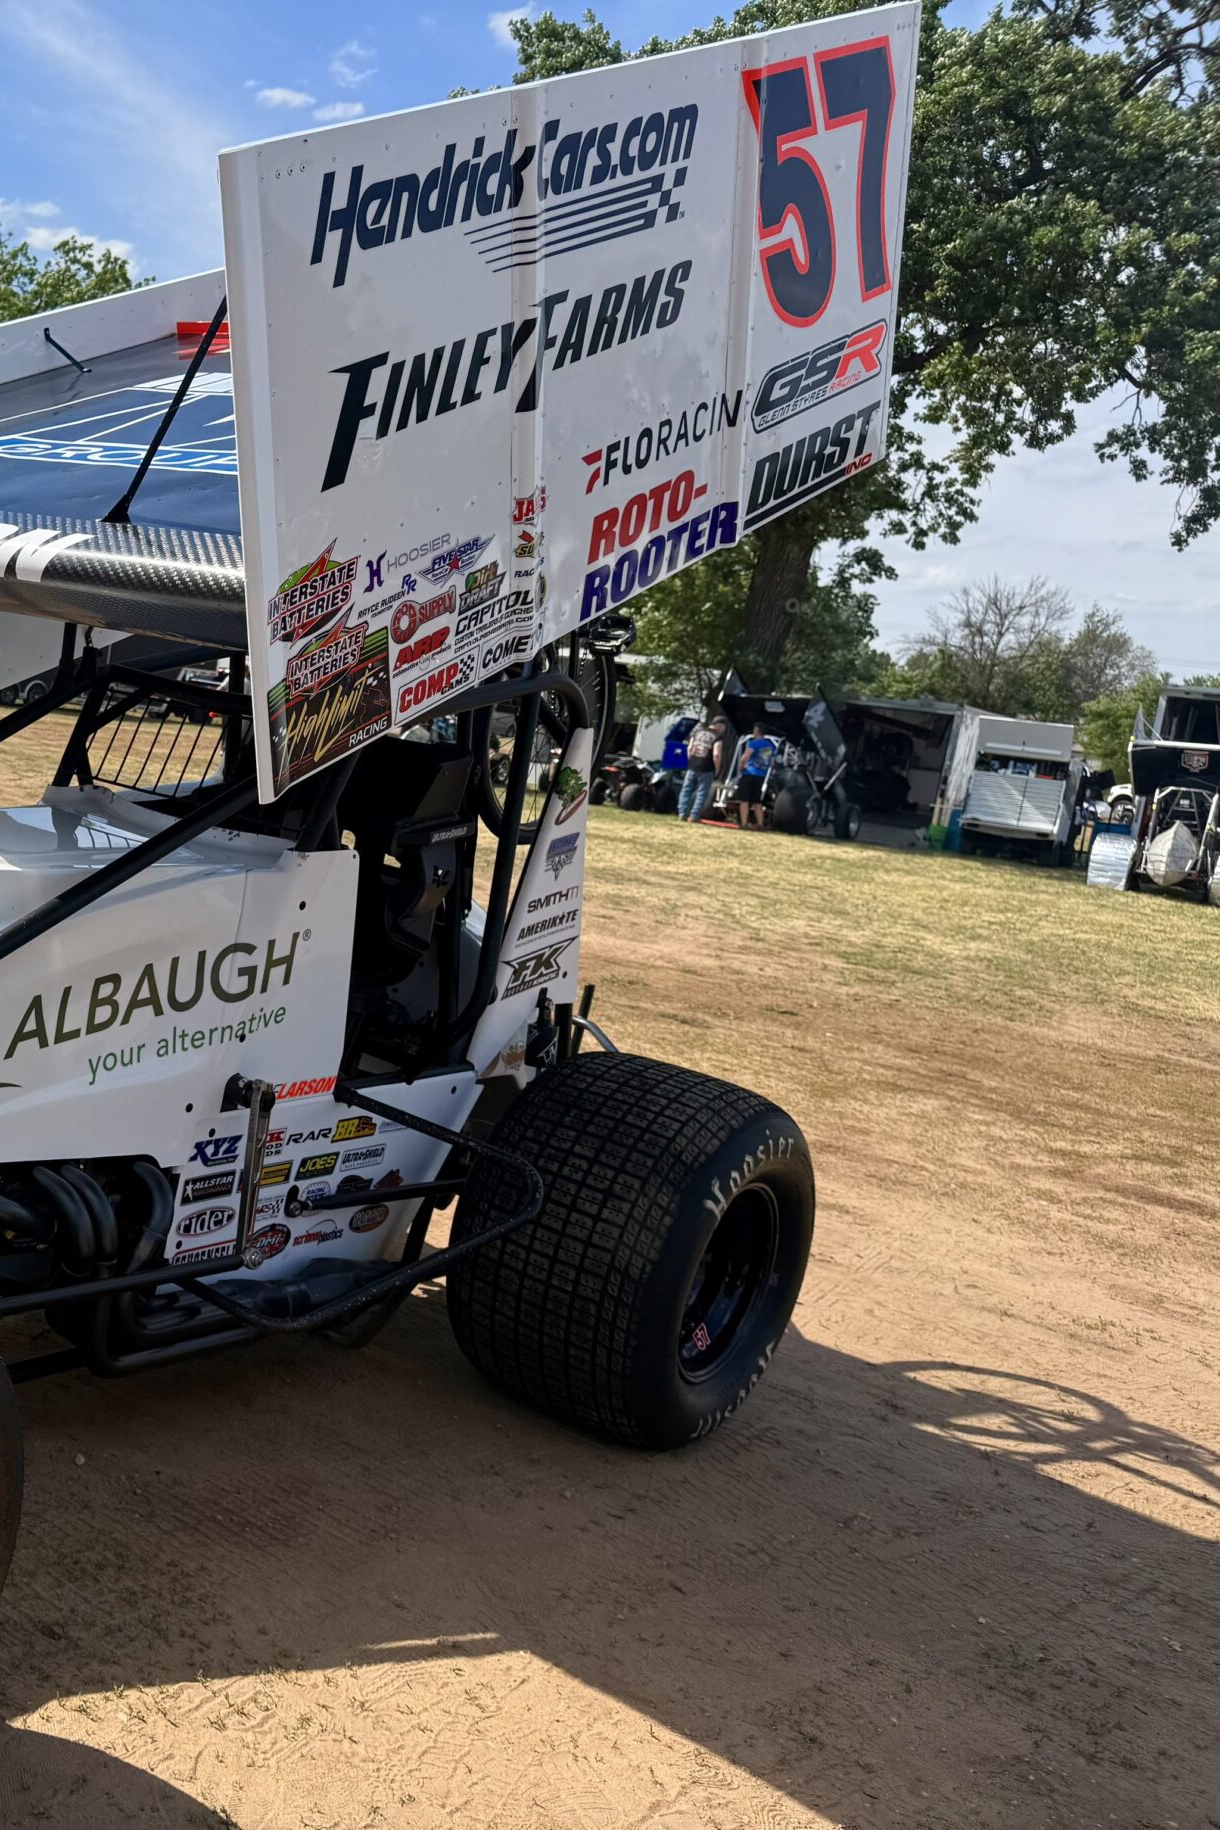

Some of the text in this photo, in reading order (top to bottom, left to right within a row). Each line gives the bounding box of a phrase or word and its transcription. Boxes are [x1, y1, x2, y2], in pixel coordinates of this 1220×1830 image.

[310, 103, 698, 288] HendrickCars.com
[741, 35, 896, 328] 57
[321, 260, 693, 492] FINLEY FARMS
[754, 324, 886, 417] GSR
[758, 371, 862, 427] GLENN STYRES RACING
[603, 389, 743, 487] FLORACIN
[746, 400, 882, 516] DURST
[845, 453, 873, 476] INC
[587, 469, 708, 565] ROTO-
[387, 533, 451, 573] HOOSIER
[458, 538, 480, 556] STAR
[579, 501, 739, 622] ROOTER
[269, 560, 356, 620] INTERSTATE
[272, 585, 351, 639] BATTERIES
[419, 591, 454, 623] SUPPLY
[455, 590, 534, 637] CAPITOL
[290, 631, 363, 677] INTERSTATE
[295, 649, 357, 691] BATTERIES
[393, 626, 451, 672] ARP
[399, 662, 459, 713] COMP
[441, 673, 470, 695] CAMS
[349, 717, 388, 747] RACING
[3, 931, 300, 1060] ALBAUGH
[88, 1004, 286, 1085] your alternative
[277, 1076, 337, 1100] LARSON
[188, 1134, 243, 1165] XYZ
[300, 1156, 337, 1173] JOES
[193, 1176, 234, 1190] ALLSTAR
[704, 1129, 795, 1220] Hoosier
[179, 1210, 233, 1235] rider
[692, 1324, 711, 1350] 57
